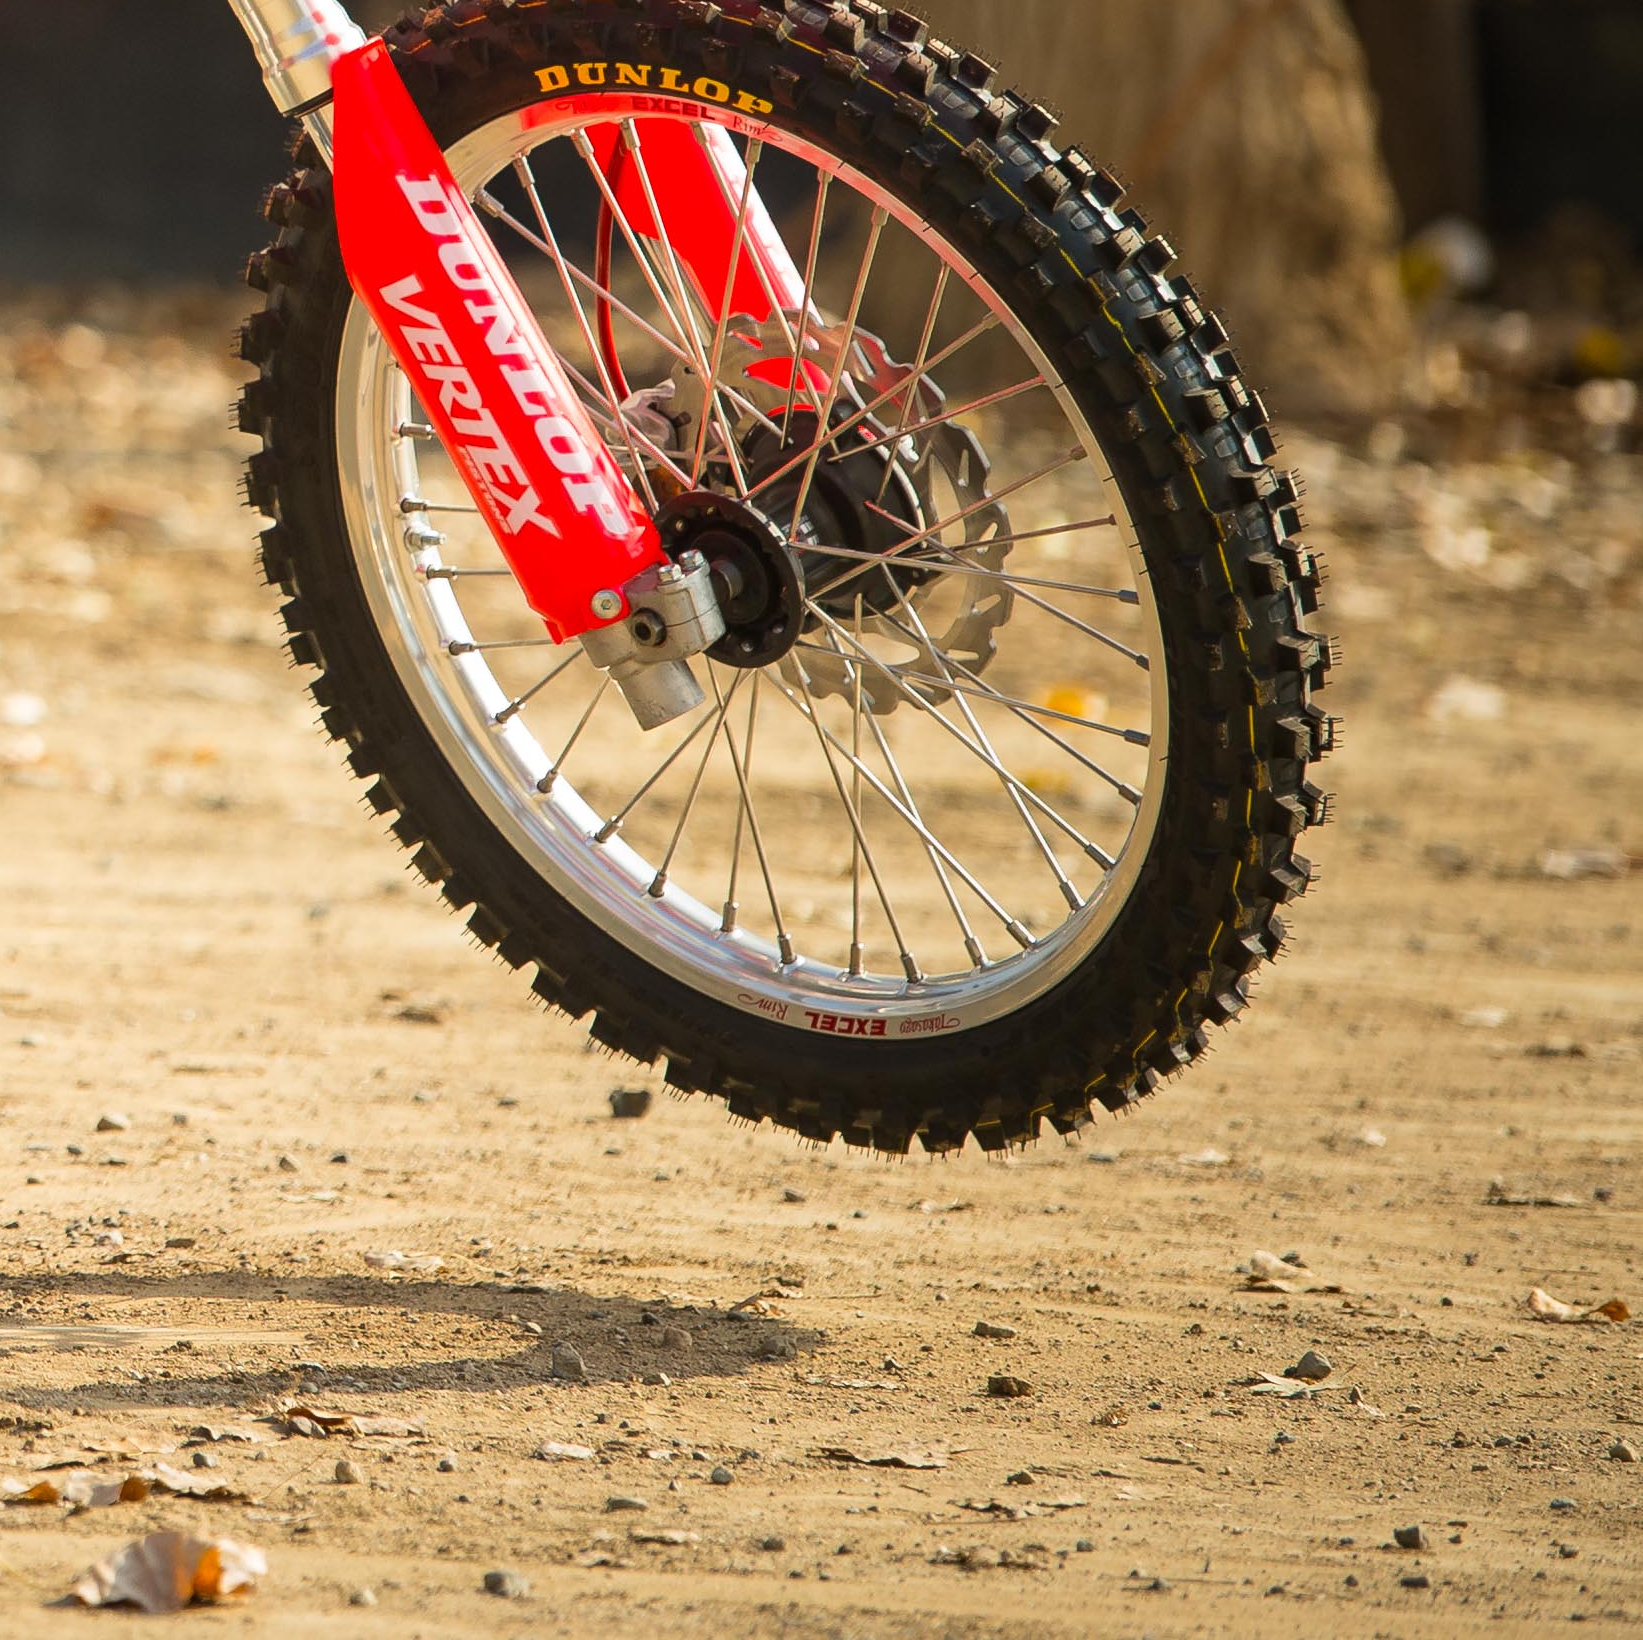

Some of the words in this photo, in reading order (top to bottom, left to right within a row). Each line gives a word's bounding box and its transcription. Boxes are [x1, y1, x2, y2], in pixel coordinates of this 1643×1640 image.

[534, 62, 773, 114] DUNLOP
[630, 96, 716, 121] EXCEL
[395, 173, 631, 536] DUNLOP
[379, 274, 563, 540] VERTEX
[805, 1011, 888, 1036] EXCEL
